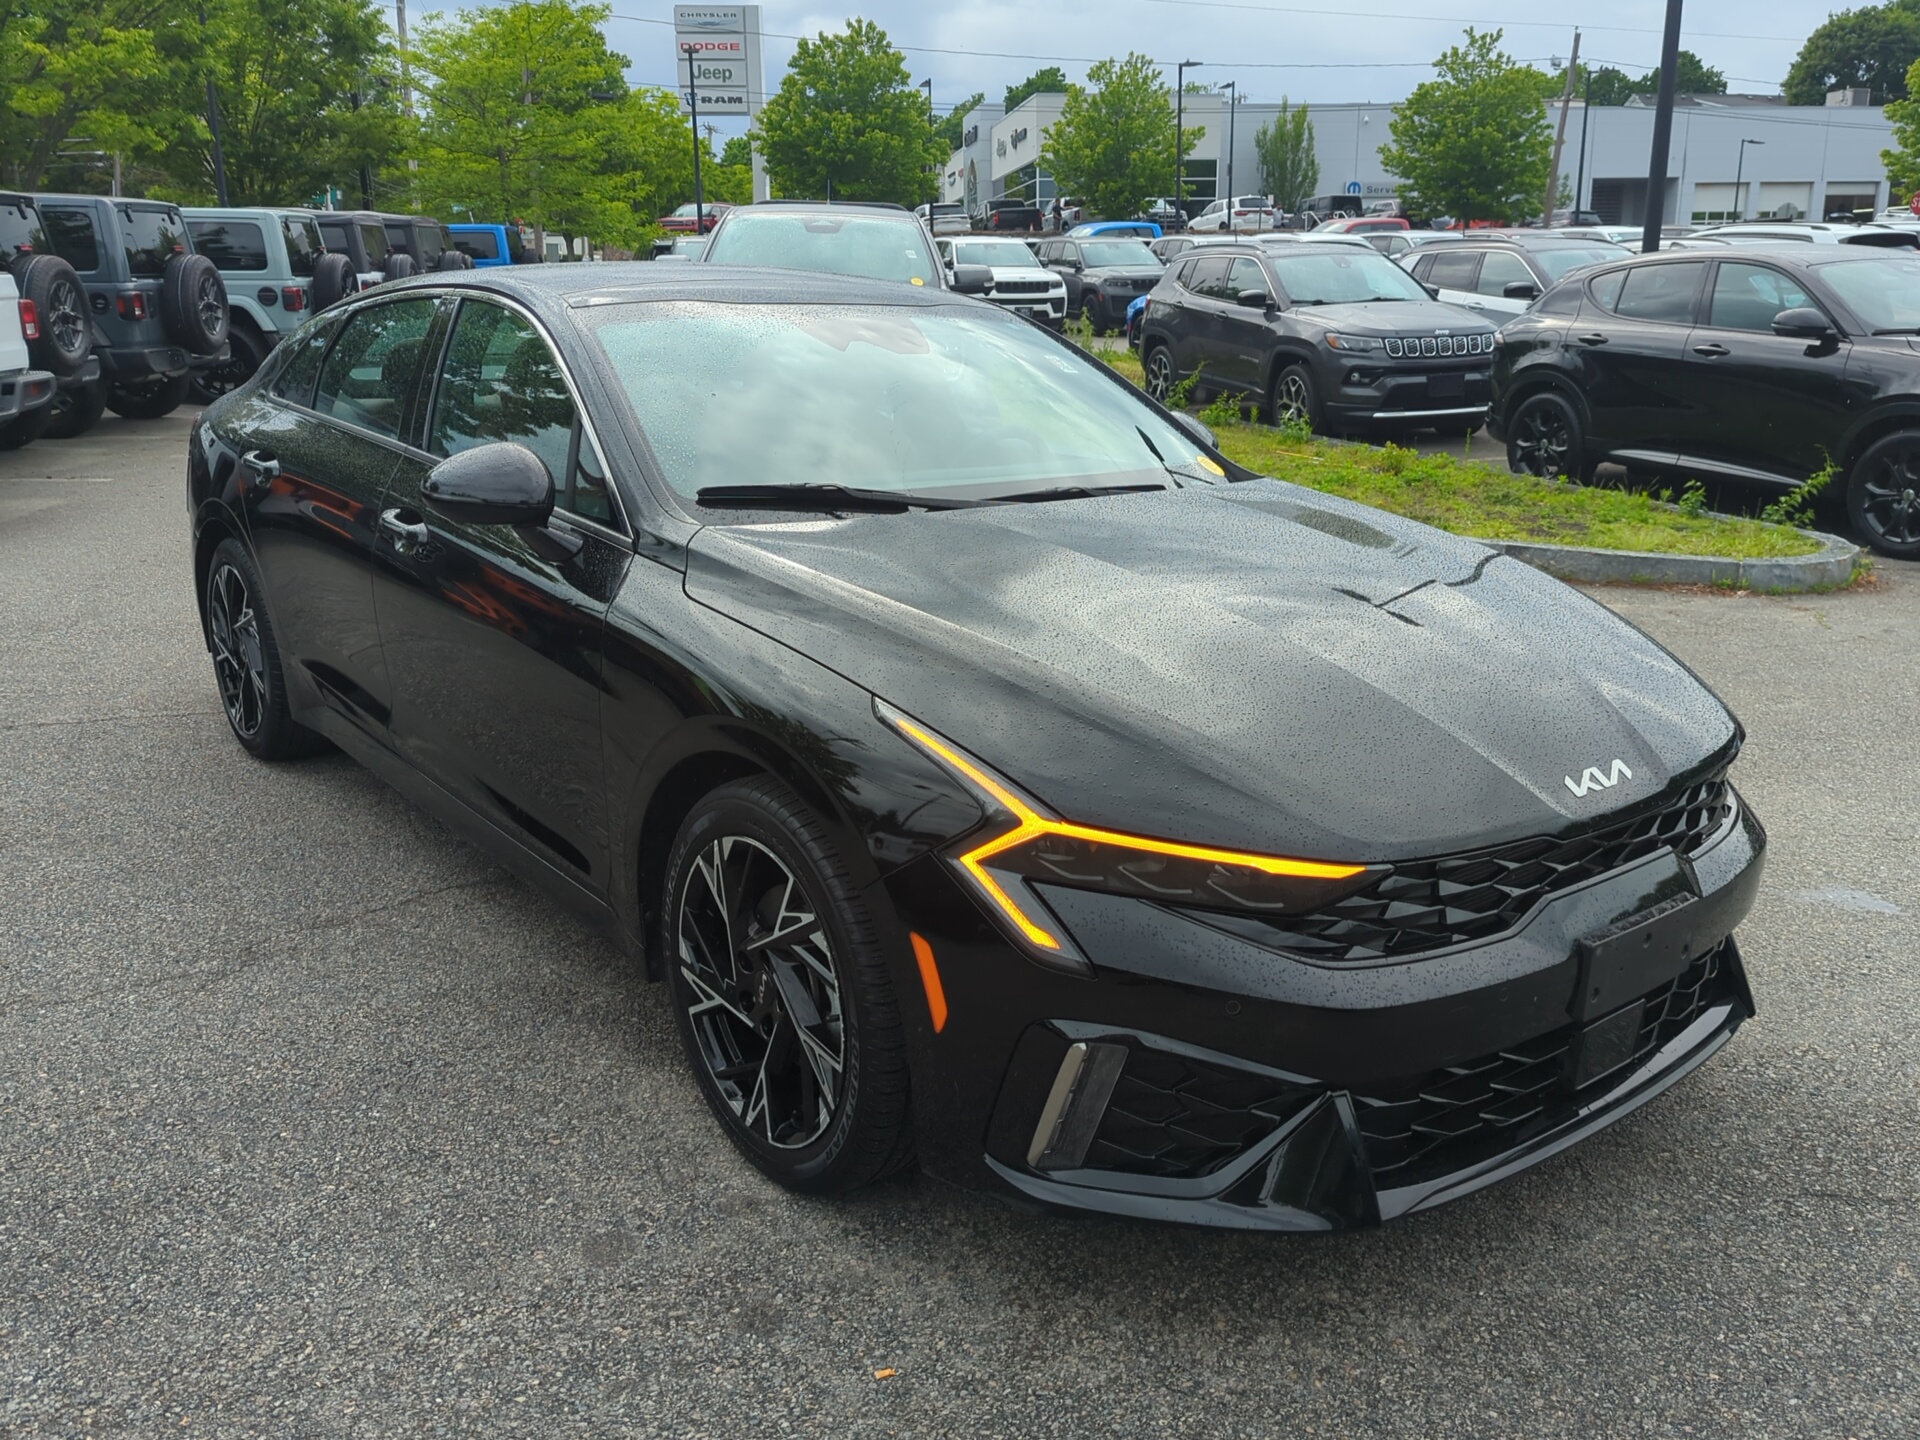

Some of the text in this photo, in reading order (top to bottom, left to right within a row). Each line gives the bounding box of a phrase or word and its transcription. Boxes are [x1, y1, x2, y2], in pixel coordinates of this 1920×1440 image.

[680, 42, 740, 51] DODGE
[693, 64, 733, 83] Jeep
[701, 96, 743, 104] RAM
[1564, 758, 1632, 797] KIA
